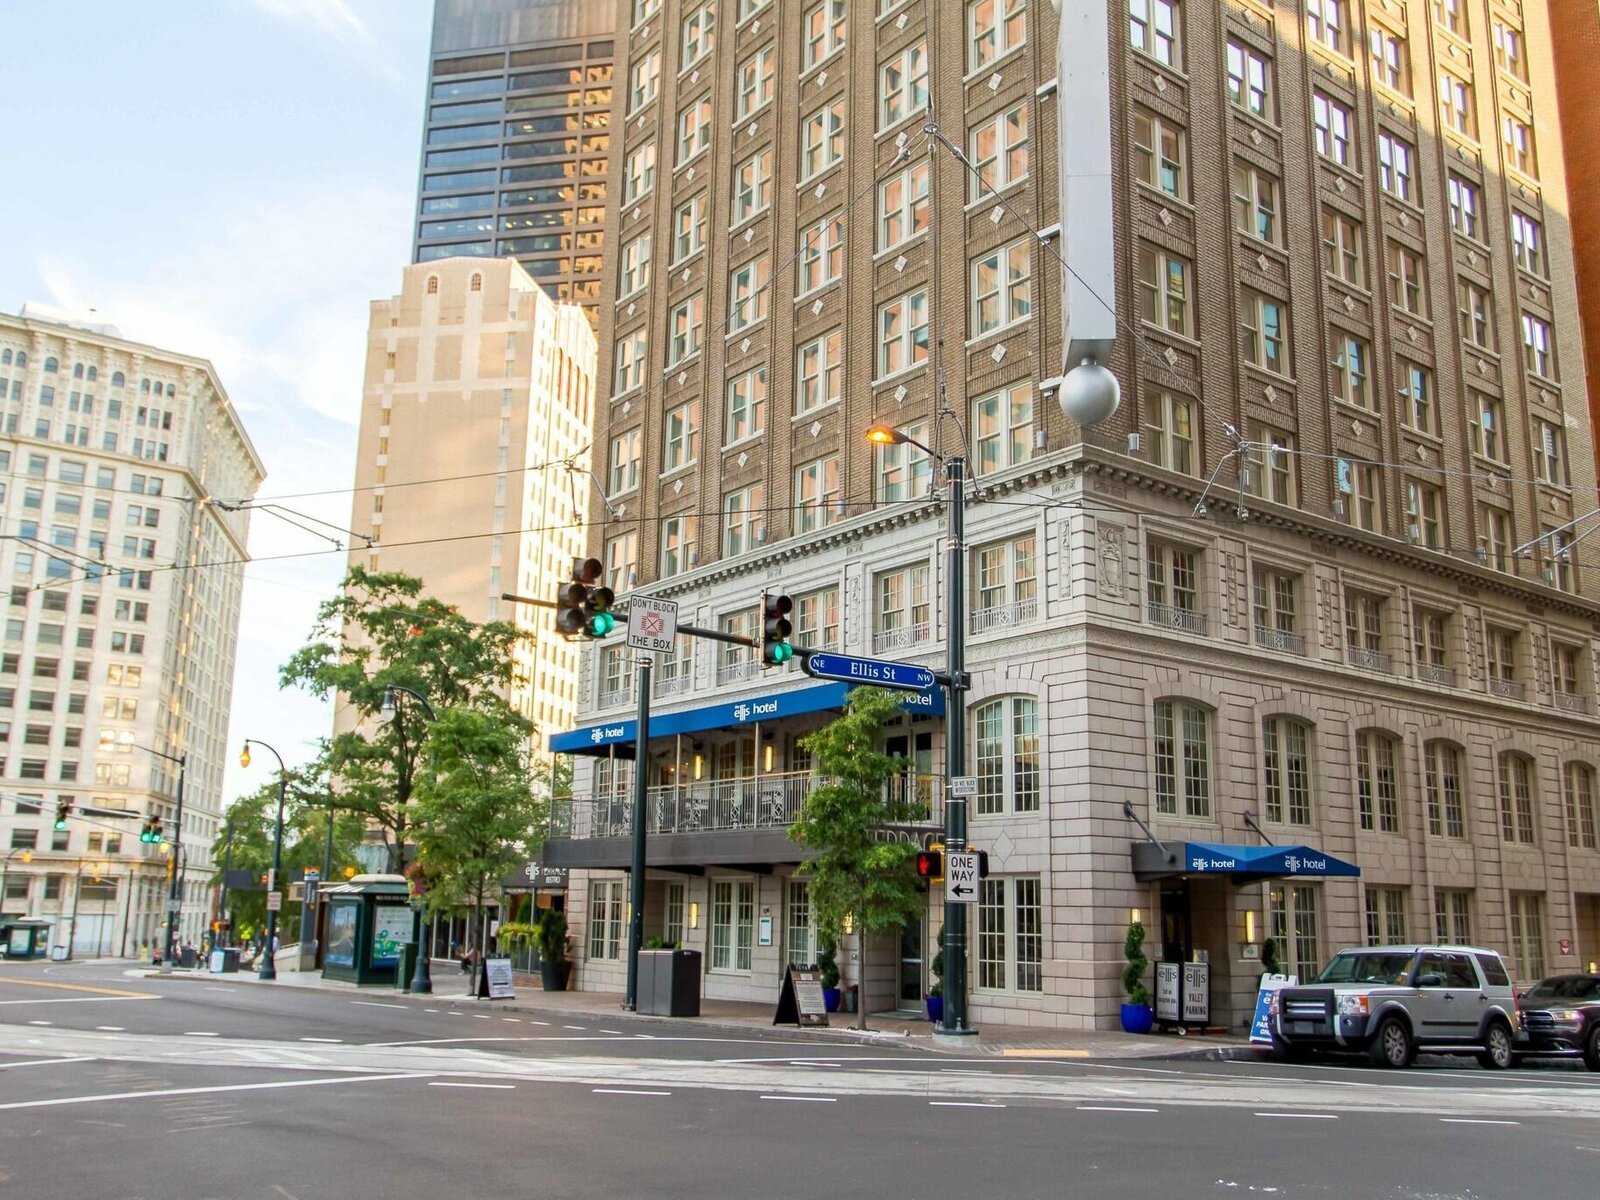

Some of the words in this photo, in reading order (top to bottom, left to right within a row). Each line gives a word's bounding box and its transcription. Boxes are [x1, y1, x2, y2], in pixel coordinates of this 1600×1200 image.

[632, 598, 652, 610] DON'T
[653, 601, 676, 614] BLOCK
[632, 635, 649, 647] THE
[653, 638, 671, 650] BOX
[812, 659, 826, 668] NE
[850, 661, 879, 678] Ellis
[882, 665, 896, 680] St
[917, 673, 931, 683] NW
[752, 699, 778, 715] hotel
[605, 726, 624, 738] hotel
[951, 856, 973, 868] ONE
[1211, 859, 1235, 868] hotel
[1303, 858, 1326, 869] hotel
[951, 870, 975, 881] WAY
[1158, 967, 1177, 983] ellis
[1186, 968, 1207, 988] ellis
[1188, 993, 1204, 1003] VALET
[1185, 1005, 1207, 1016] PARKING
